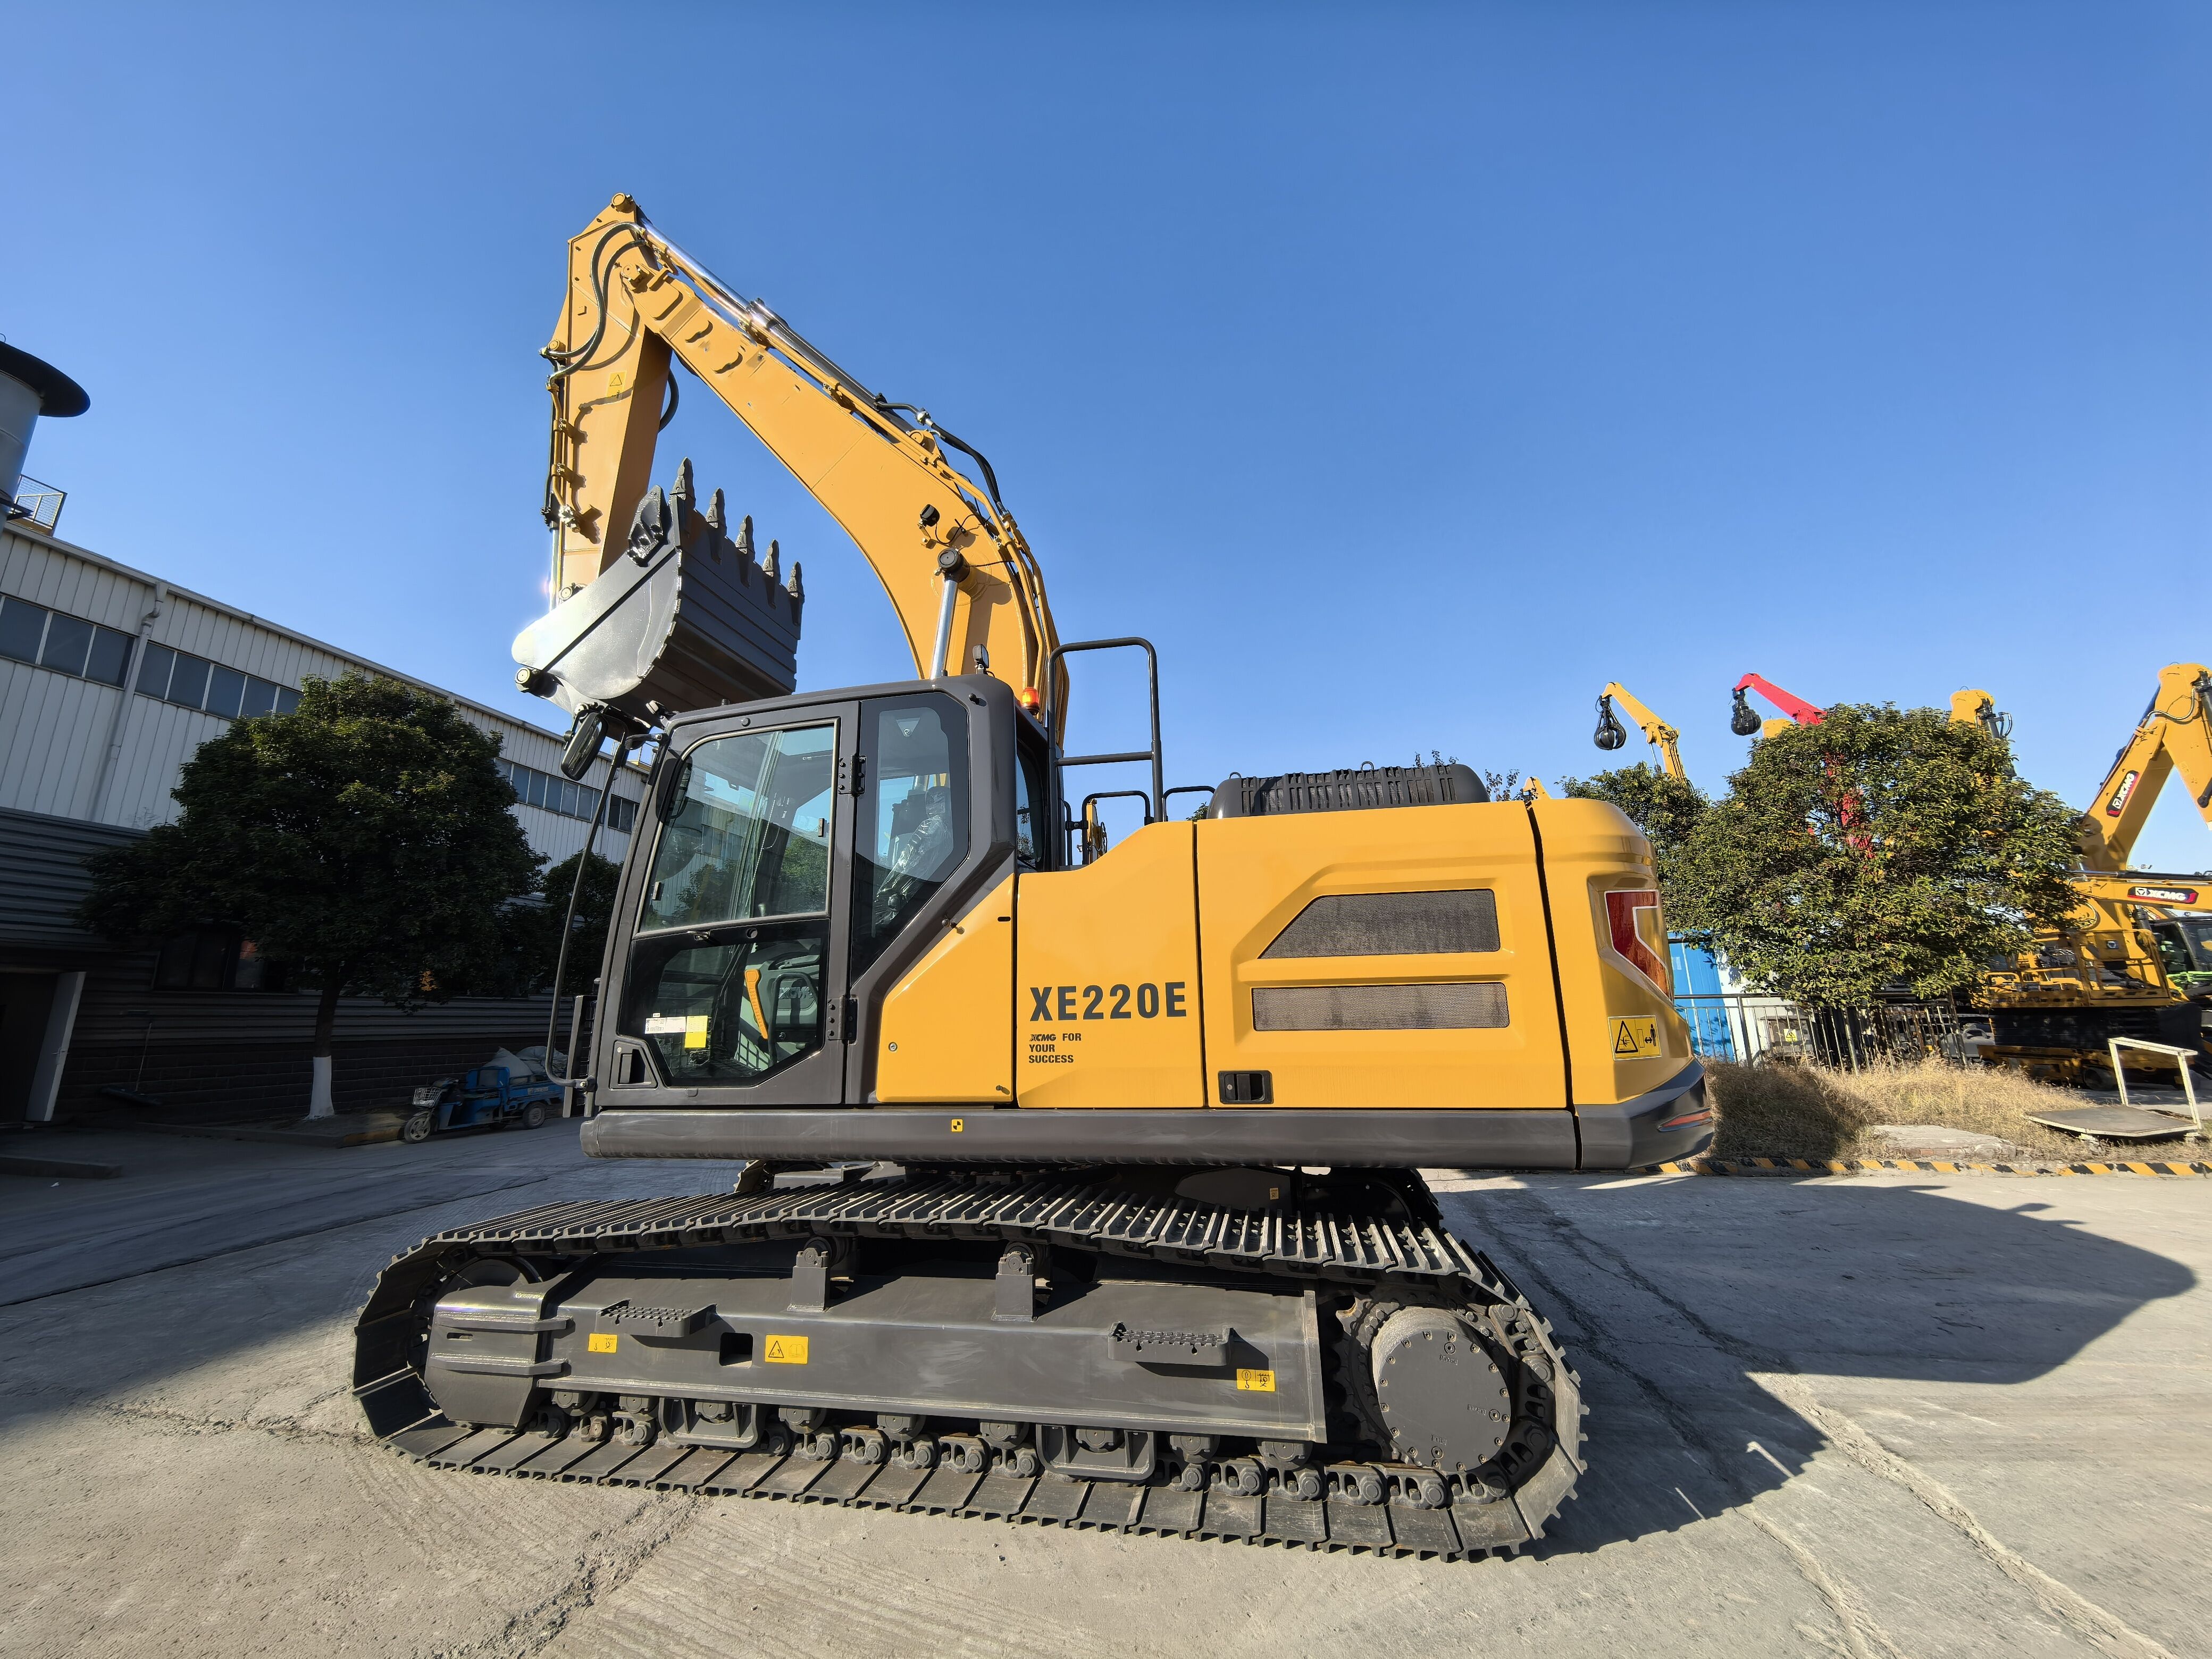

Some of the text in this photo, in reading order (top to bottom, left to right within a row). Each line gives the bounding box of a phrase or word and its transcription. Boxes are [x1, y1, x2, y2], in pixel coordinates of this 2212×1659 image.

[2117, 773, 2135, 801] XCMG
[2148, 889, 2186, 901] XCMG
[1030, 982, 1186, 1021] XE220E
[1028, 1055, 1074, 1063] SUCCESS
